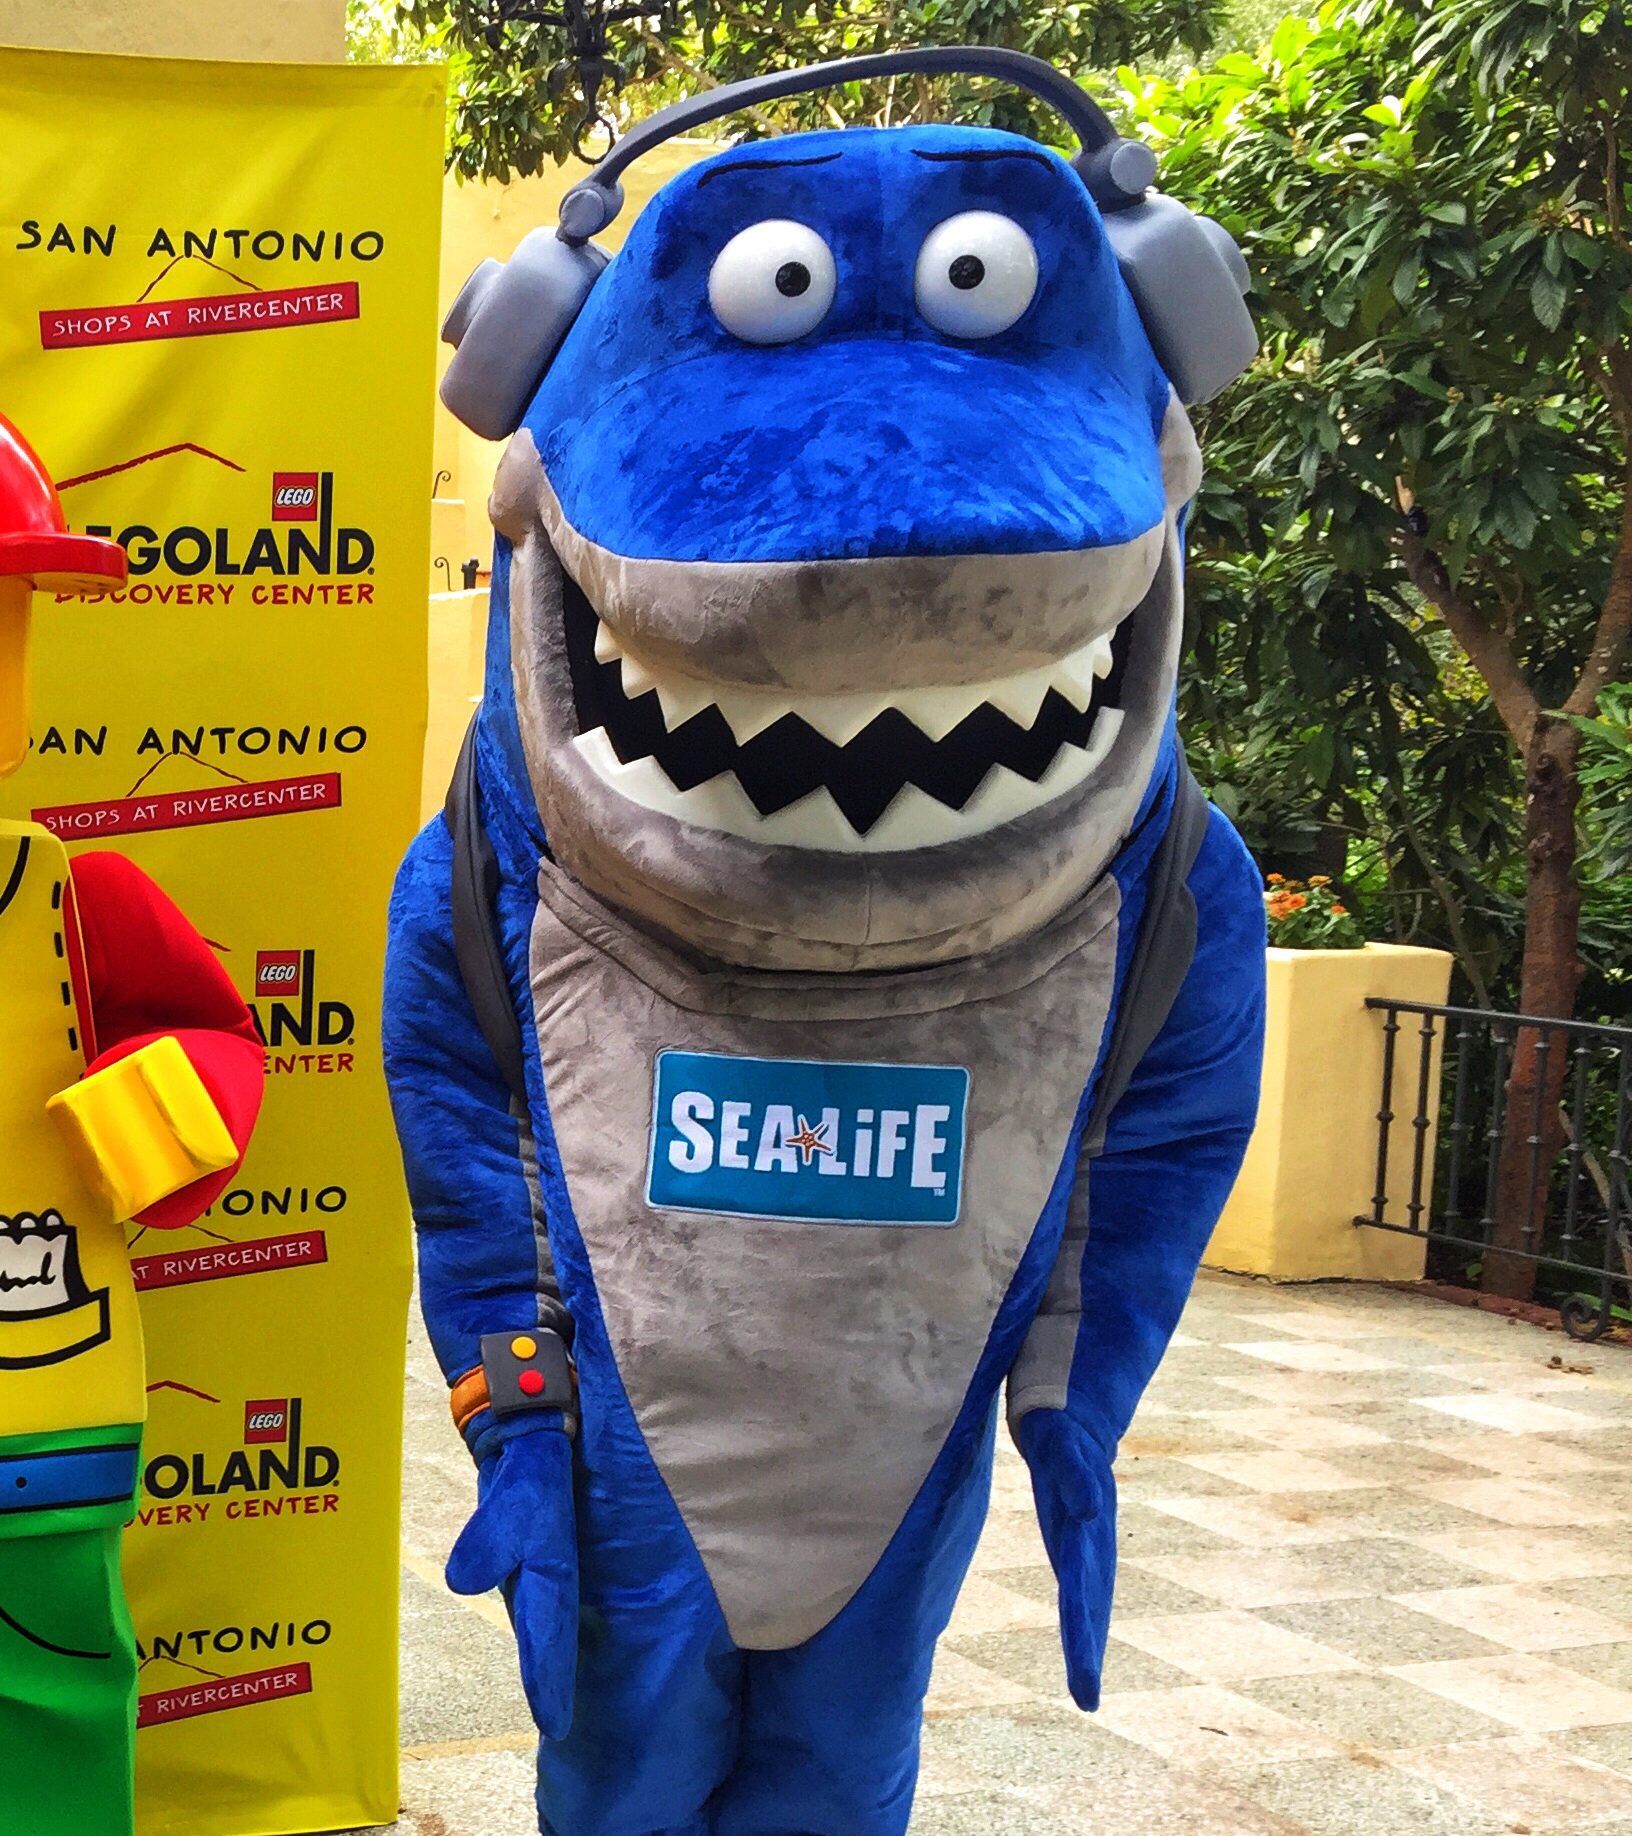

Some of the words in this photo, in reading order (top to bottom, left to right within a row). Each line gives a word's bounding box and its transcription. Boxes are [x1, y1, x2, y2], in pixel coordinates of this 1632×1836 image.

[16, 220, 117, 257] SAN
[147, 227, 384, 262] ANTONIO
[54, 315, 131, 335] SHOPS
[145, 310, 172, 329] AT
[187, 293, 343, 324] RIVERCENTER
[276, 488, 314, 506] LEGO
[66, 471, 375, 577] GOLAND
[251, 583, 375, 605] CENTER
[28, 725, 108, 756] AN
[136, 725, 367, 756] ANTONIO
[46, 809, 120, 830] SHOPS
[133, 804, 159, 821] AT
[173, 783, 326, 816] RIVERCENTER
[260, 965, 296, 982] LEGO
[668, 1091, 798, 1173] SEA
[205, 1185, 347, 1217] ONIO
[163, 1241, 311, 1276] RIVERCENTER
[248, 1413, 284, 1429] LEGO
[225, 1493, 339, 1520] CENTER
[157, 1672, 297, 1710] RIVERCENTER
